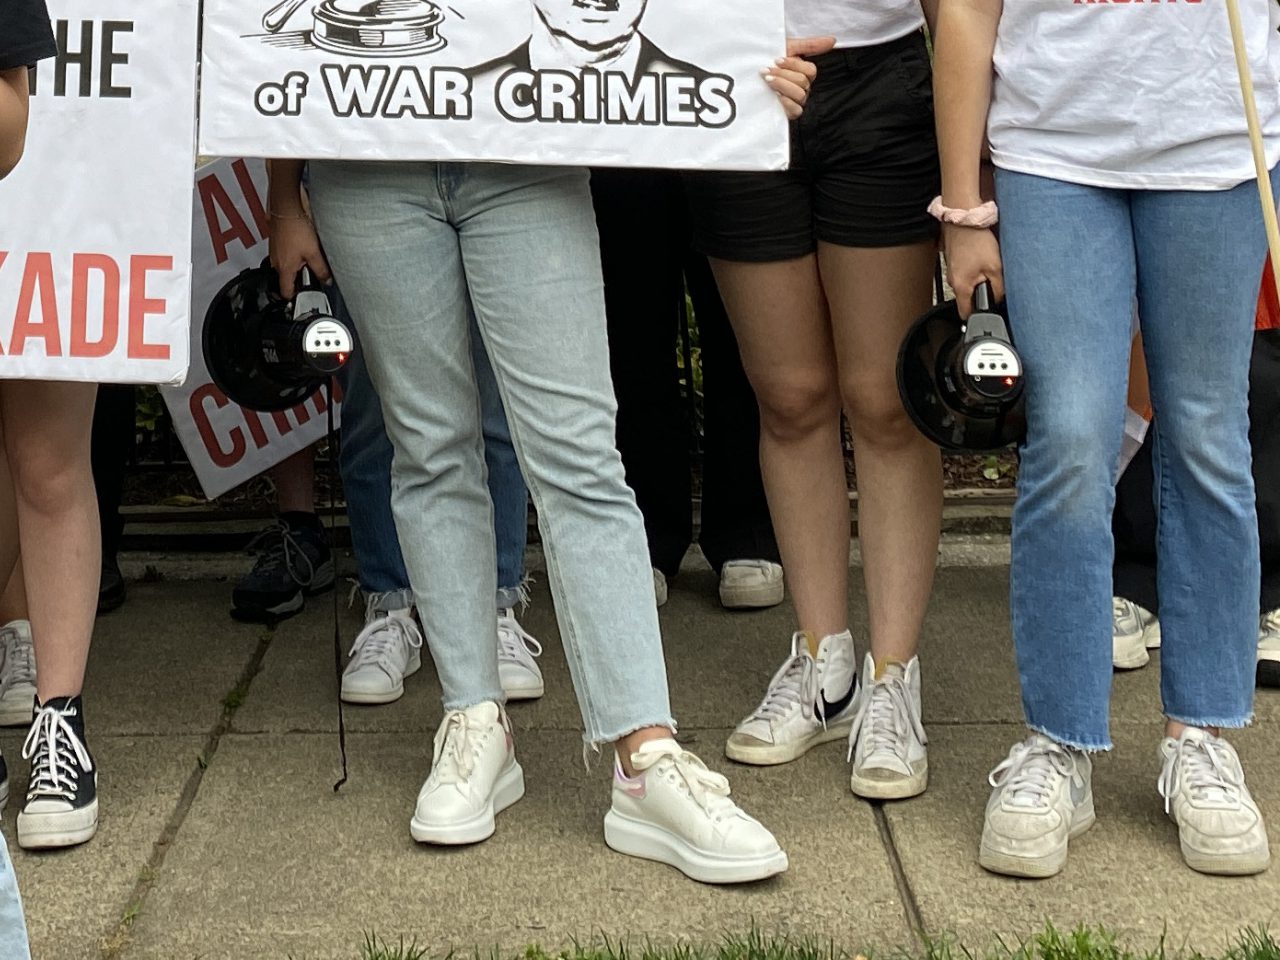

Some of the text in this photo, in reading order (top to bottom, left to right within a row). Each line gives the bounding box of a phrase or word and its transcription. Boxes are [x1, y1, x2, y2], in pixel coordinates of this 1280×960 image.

[28, 19, 134, 98] HE
[255, 65, 737, 127] of WAR CRIMES
